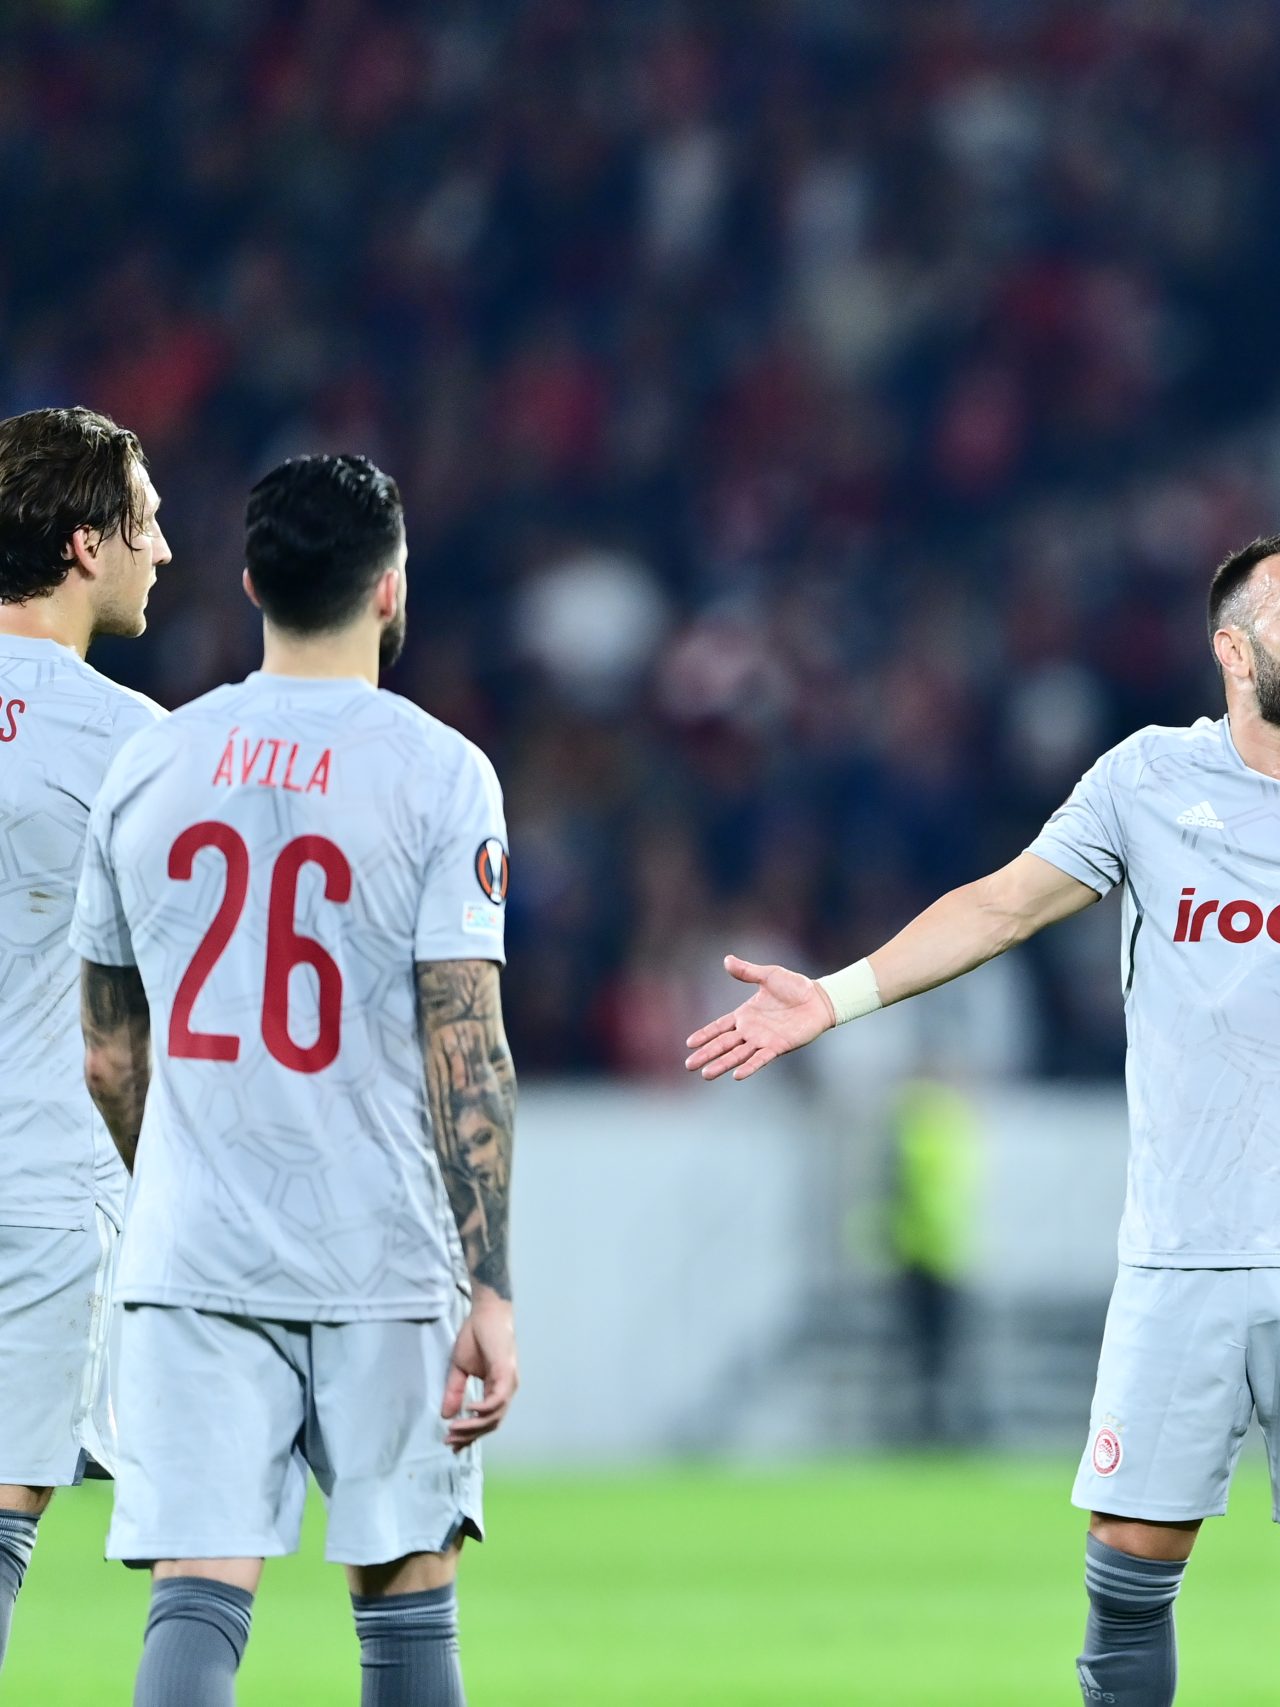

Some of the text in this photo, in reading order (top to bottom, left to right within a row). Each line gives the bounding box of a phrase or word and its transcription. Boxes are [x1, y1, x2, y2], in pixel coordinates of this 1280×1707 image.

[0, 696, 26, 742] S
[212, 727, 332, 795] ÁVILA
[1176, 815, 1225, 830] adidas
[168, 820, 352, 1074] 26
